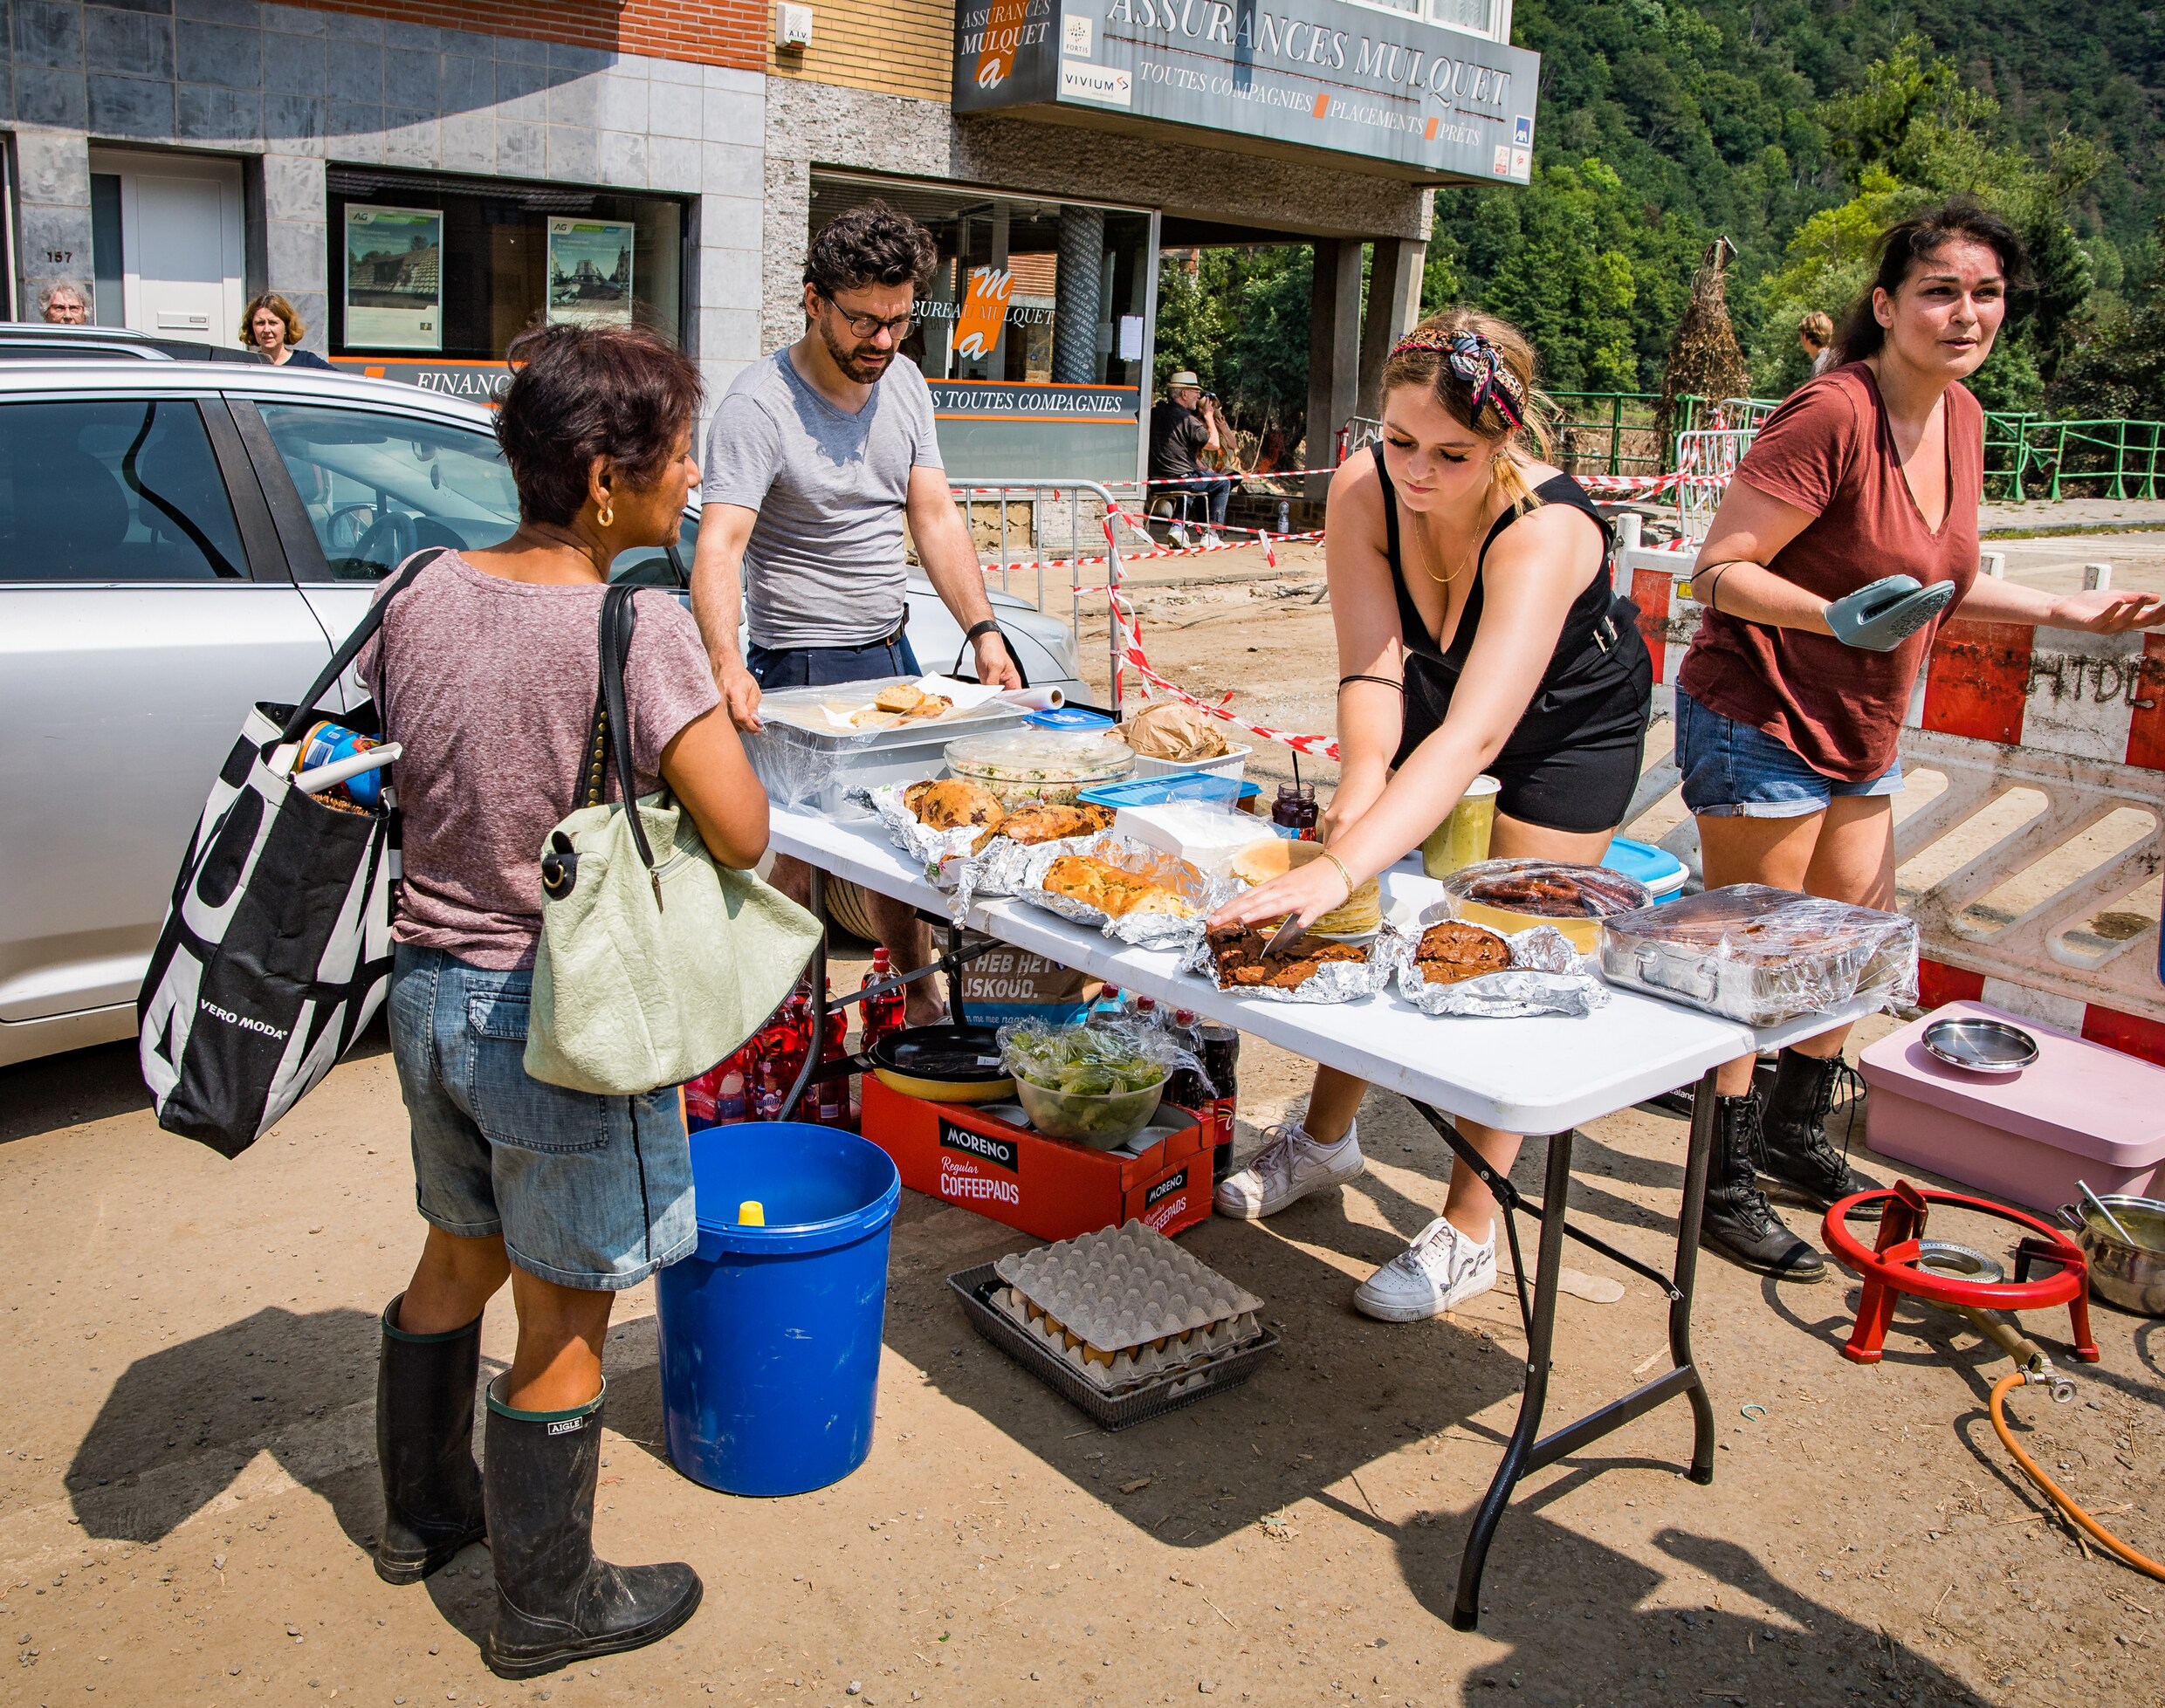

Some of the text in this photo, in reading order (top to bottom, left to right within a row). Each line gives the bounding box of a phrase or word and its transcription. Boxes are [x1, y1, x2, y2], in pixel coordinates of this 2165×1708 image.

[962, 0, 1050, 30] ASSURANCES
[960, 22, 1050, 56] MULQUET
[1066, 44, 1089, 54] FORTIS
[1105, 0, 1512, 108] ASSURANCES MULQUET
[1065, 73, 1114, 92] VIVIUM
[1140, 61, 1481, 147] TOUTES COMPAGNIES PLACEMENTS PRÊTS
[353, 212, 368, 221] AG
[46, 250, 73, 264] 157
[979, 304, 1055, 328] MULQUET
[947, 391, 1014, 409] TOUTES
[1019, 394, 1123, 413] COMPAGNIES
[975, 954, 1014, 972] HEB
[961, 977, 1039, 998] JSKOUD.
[201, 998, 238, 1024] VERO
[947, 1127, 1010, 1161] MORENO
[941, 1156, 979, 1176] Regular
[940, 1172, 1020, 1205] COFFEEPADS
[1149, 1175, 1183, 1203] MORENO
[552, 1420, 580, 1433] AIGLE
